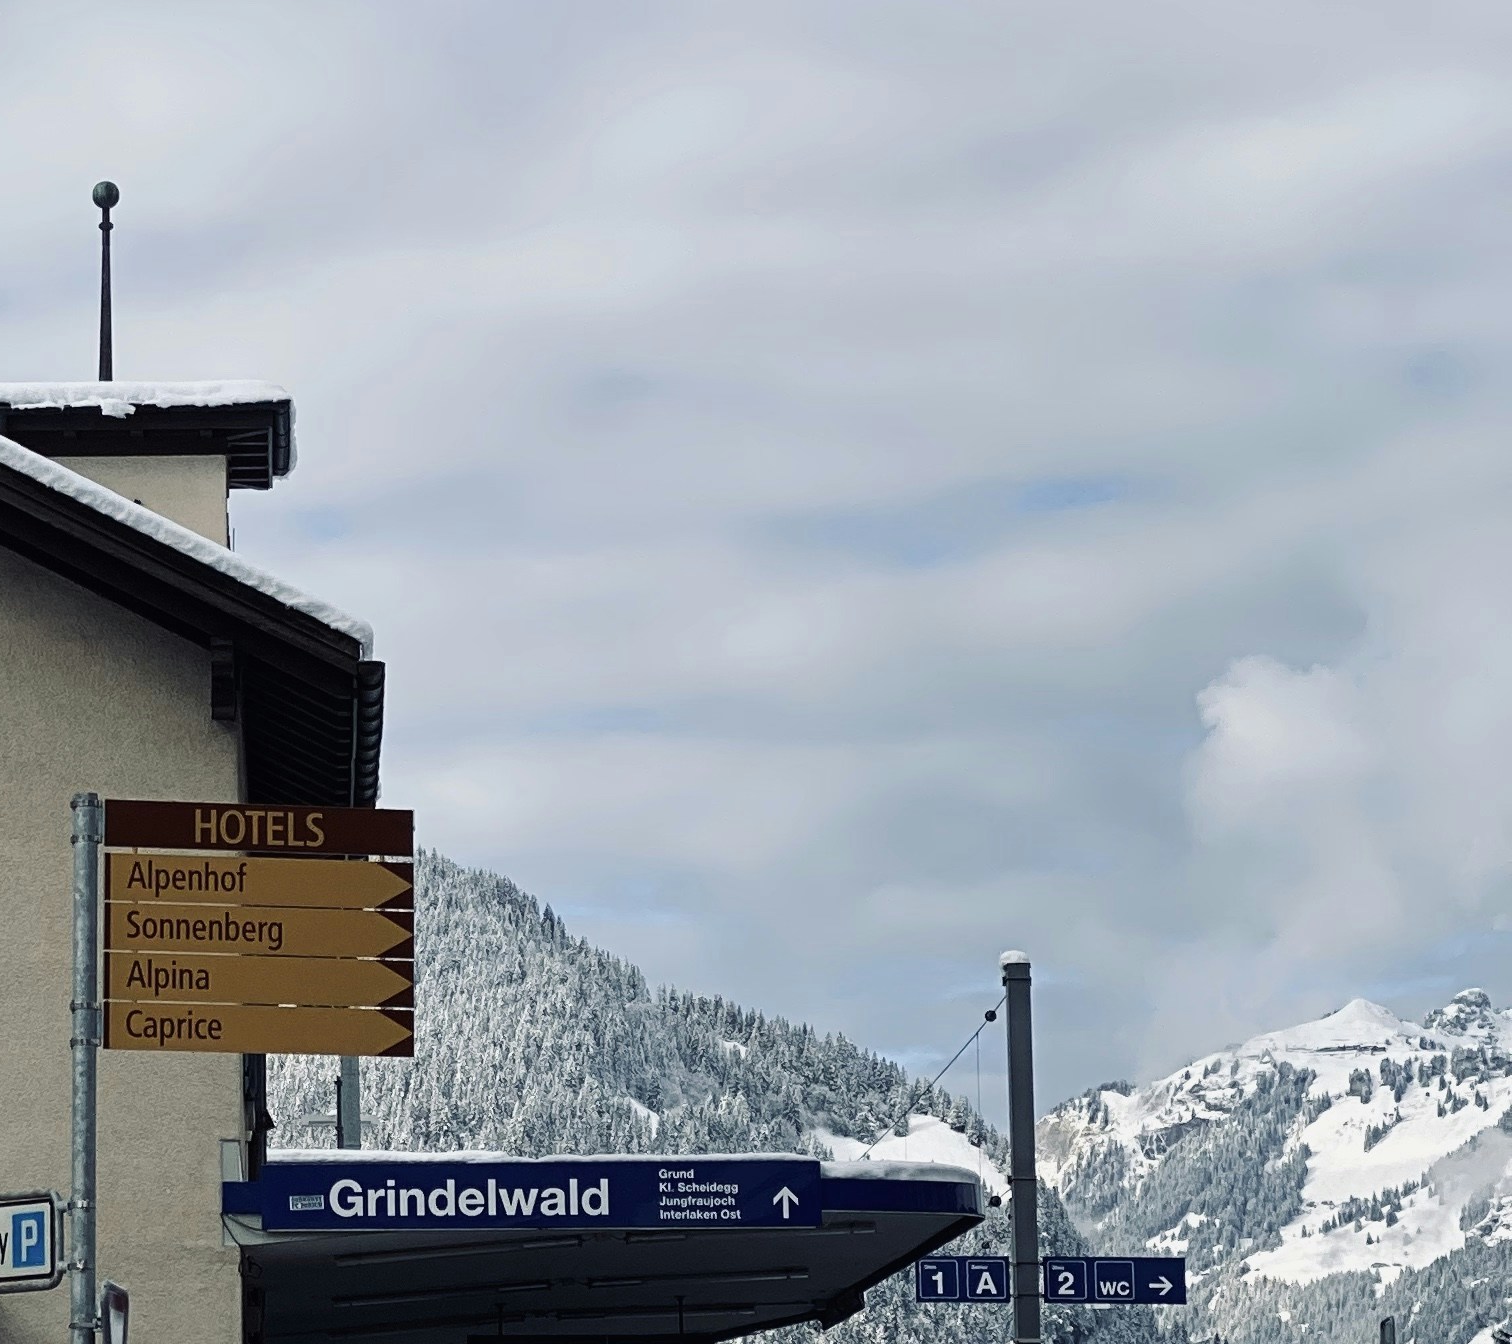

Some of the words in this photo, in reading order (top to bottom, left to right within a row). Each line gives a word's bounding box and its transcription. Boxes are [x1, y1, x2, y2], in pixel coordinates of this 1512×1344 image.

[193, 808, 325, 848] HOTELS
[126, 860, 247, 895] Alpenhof
[126, 910, 284, 951] Sonnenberg
[126, 959, 210, 996] Alpina
[125, 1010, 223, 1045] Caprice
[658, 1182, 675, 1193] Kl.
[677, 1182, 739, 1194] Scheidegg
[659, 1168, 694, 1179] Grund
[328, 1176, 609, 1219] Grindelwald
[659, 1196, 736, 1207] Jungfraujoch
[659, 1209, 718, 1219] Interlaken
[720, 1209, 742, 1219] Ost
[20, 1219, 39, 1263] P
[931, 1271, 944, 1295] 1
[975, 1271, 997, 1295] A
[1057, 1271, 1075, 1296] 2
[1099, 1280, 1130, 1296] WC
